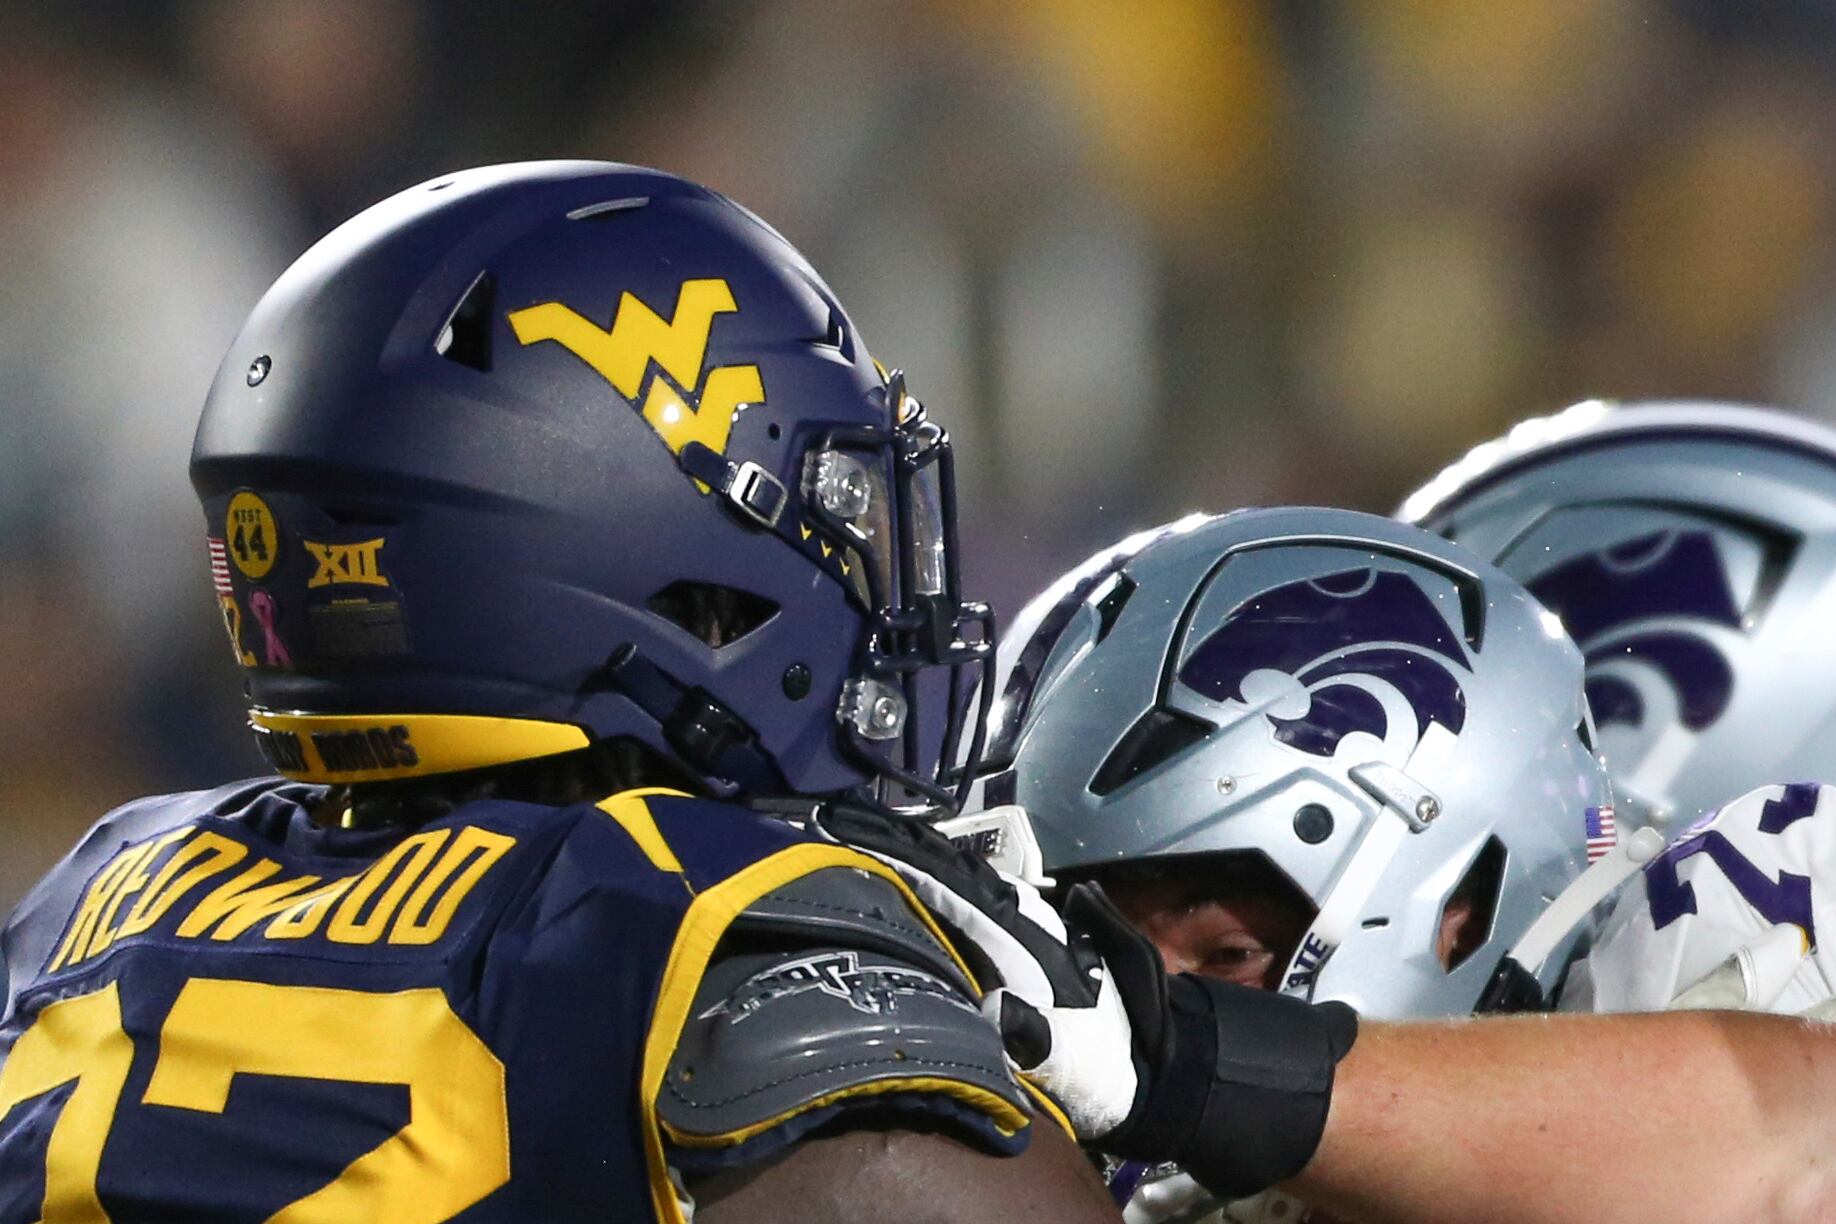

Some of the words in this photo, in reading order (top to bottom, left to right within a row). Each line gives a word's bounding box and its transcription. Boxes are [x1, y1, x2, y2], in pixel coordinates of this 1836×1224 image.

[234, 524, 268, 562] 44
[303, 537, 389, 589] XII
[48, 825, 517, 974] REDWOOD
